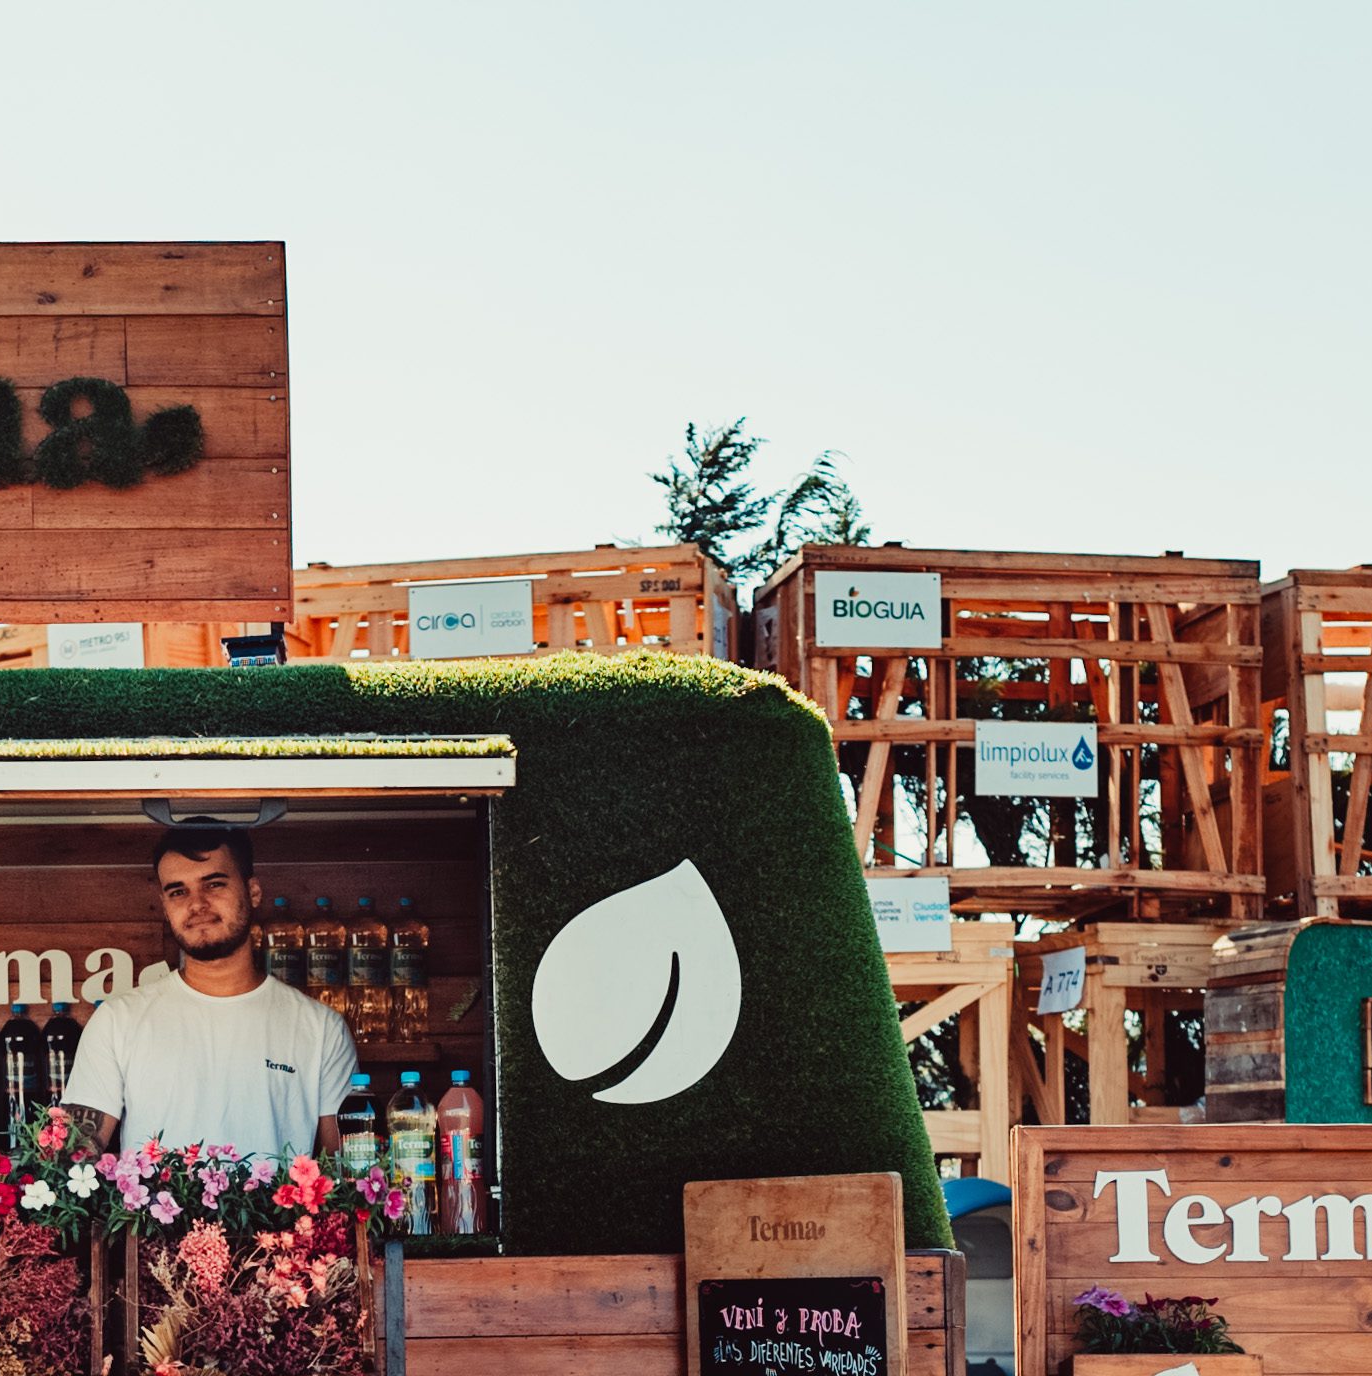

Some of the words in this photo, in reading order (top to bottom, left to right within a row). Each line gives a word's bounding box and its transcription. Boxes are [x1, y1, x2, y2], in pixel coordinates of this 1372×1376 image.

[833, 599, 925, 620] BIOGUIA
[490, 619, 526, 628] carbon
[79, 634, 113, 648] METRO
[980, 741, 1068, 767] limpiolux
[1010, 771, 1036, 782] facility
[1038, 772, 1069, 780] services
[914, 913, 944, 922] Verde
[265, 1059, 294, 1073] Terma
[398, 1140, 431, 1150] Terma
[747, 1215, 819, 1242] Terma
[719, 1339, 743, 1363] LAS
[749, 1340, 815, 1370] DIFERENTES
